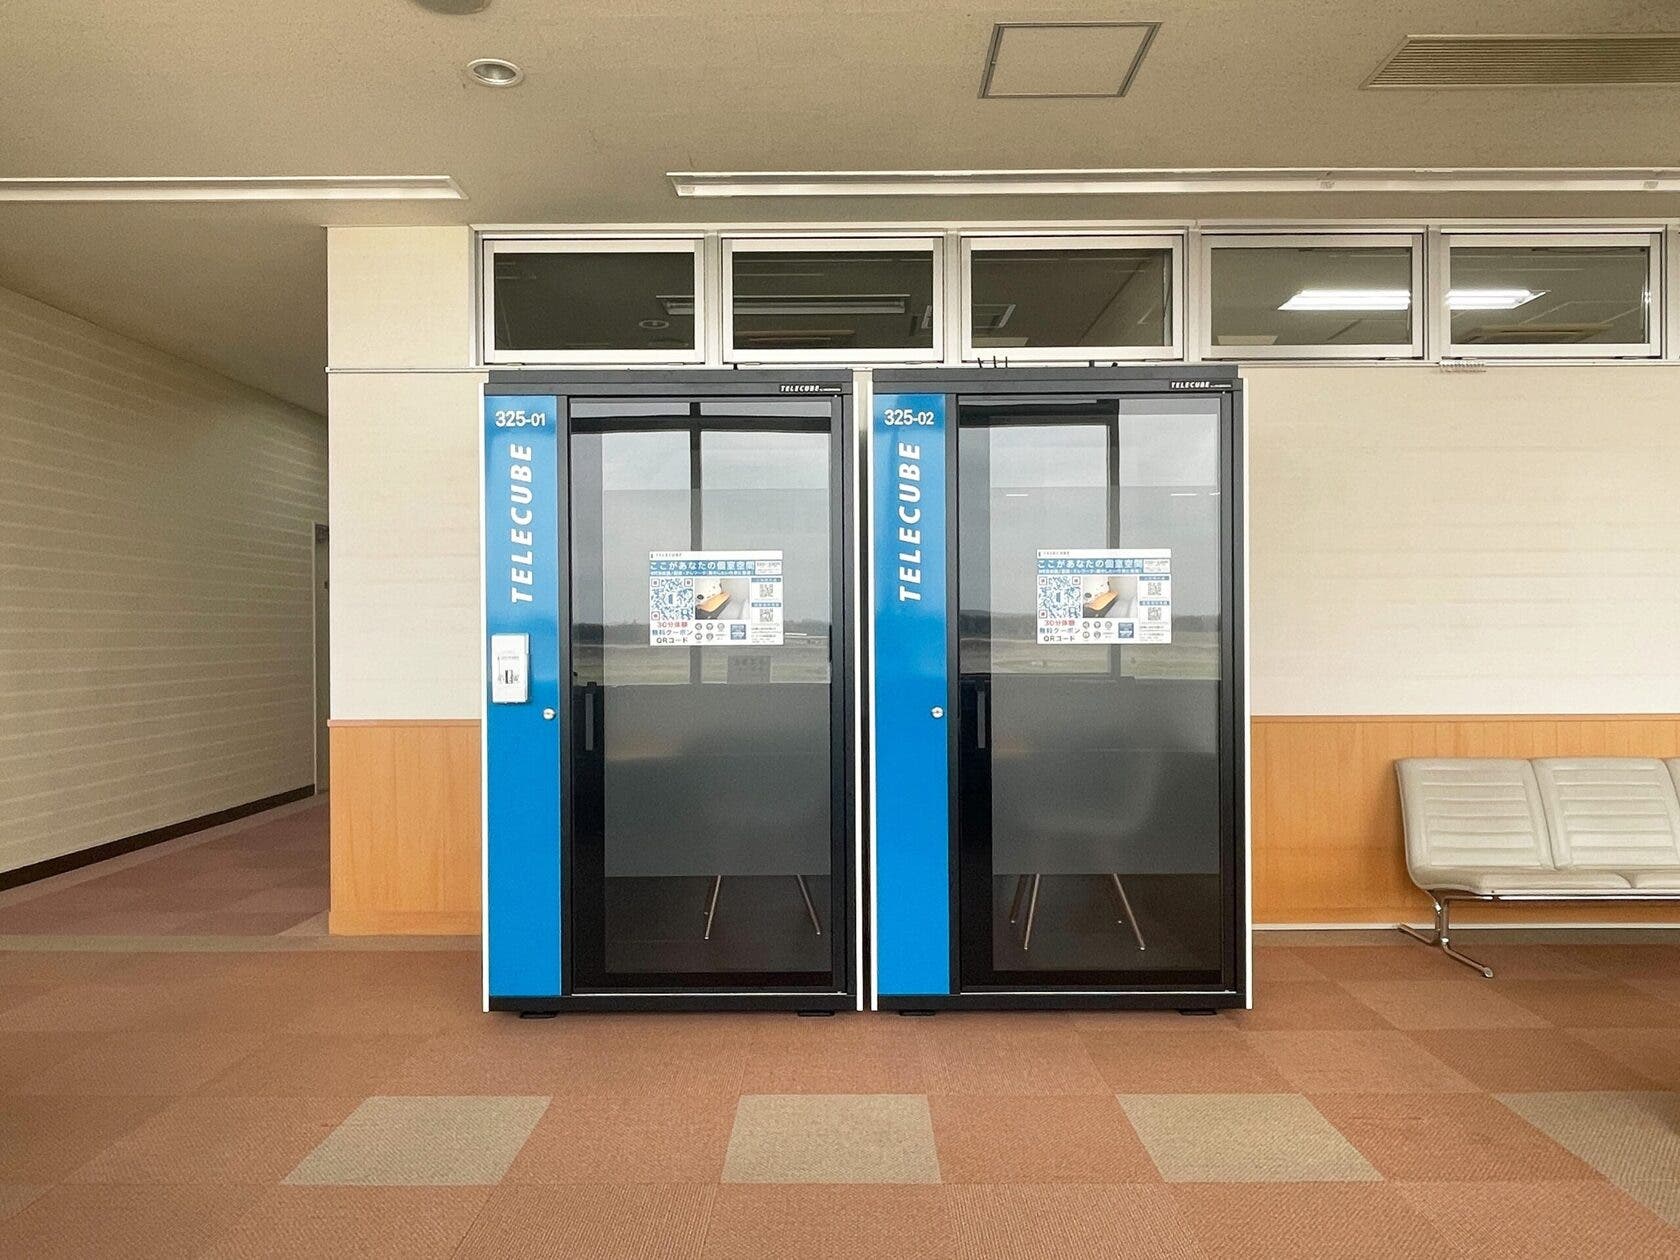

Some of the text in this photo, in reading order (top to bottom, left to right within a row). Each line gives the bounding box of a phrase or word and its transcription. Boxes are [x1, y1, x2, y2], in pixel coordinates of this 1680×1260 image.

[495, 410, 546, 427] 325-01
[884, 409, 935, 426] 325-02
[510, 443, 533, 604] TELECUBE
[899, 442, 922, 602] TELECUBE
